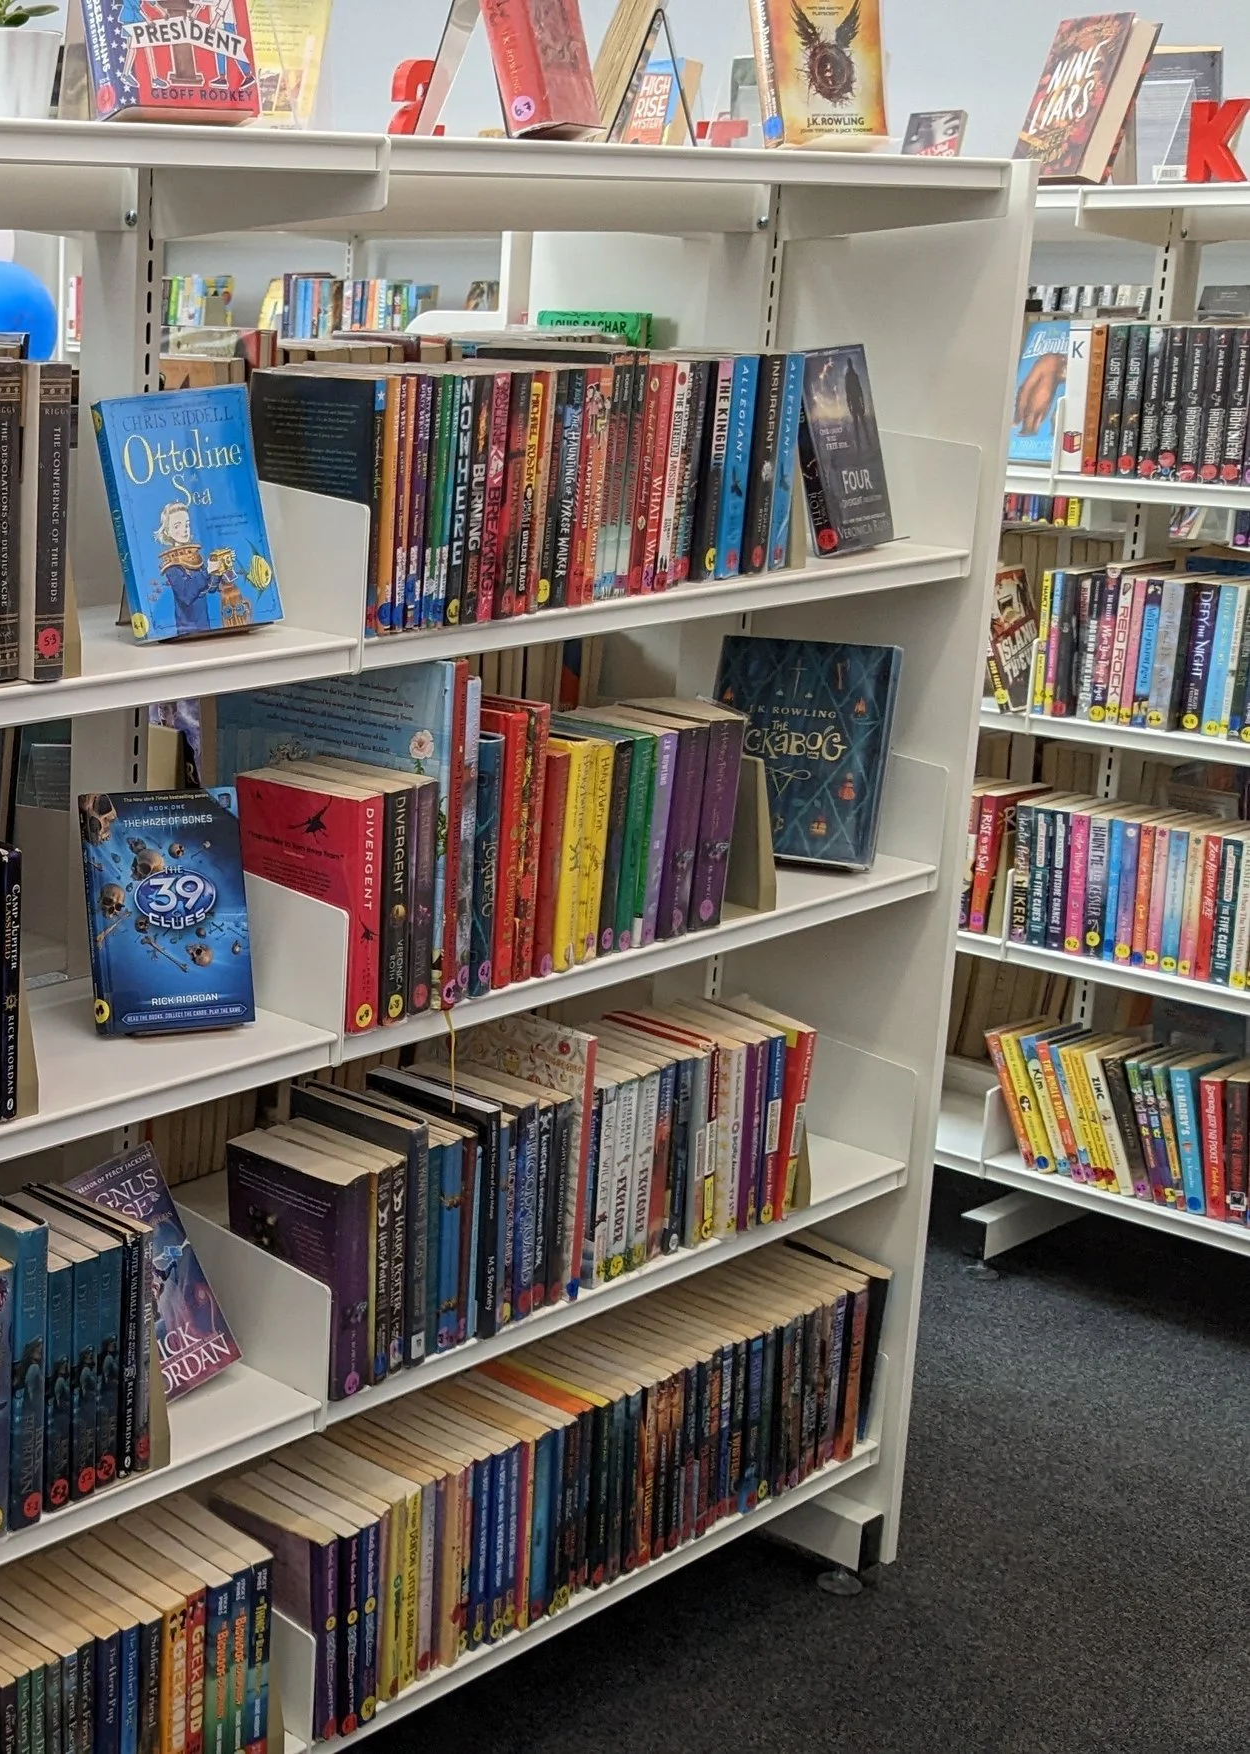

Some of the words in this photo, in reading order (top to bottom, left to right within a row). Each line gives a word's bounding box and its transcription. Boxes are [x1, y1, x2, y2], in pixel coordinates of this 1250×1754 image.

[133, 17, 241, 56] PRESIDENT
[1047, 39, 1111, 94] NINE
[152, 88, 194, 100] GEOFF
[200, 89, 252, 101] RODKEY
[640, 76, 670, 97] HIGH
[635, 96, 668, 118] RISE
[821, 117, 864, 126] ROWLING
[1029, 80, 1096, 134] LIARS
[1185, 97, 1250, 184] K
[1071, 340, 1085, 359] K
[122, 414, 167, 433] CHRIS
[173, 407, 233, 426] RIDDELL
[735, 364, 749, 462] ALLEGIANT
[765, 360, 782, 452] INSURGENT
[123, 429, 243, 485] Ottoline
[52, 451, 61, 526] CONFERENCE
[171, 474, 212, 506] Sea
[841, 469, 873, 494] FOUR
[468, 463, 486, 551] BURNING
[555, 538, 570, 578] WALKER
[50, 569, 58, 603] BIRDS
[1116, 606, 1129, 643] RED
[1198, 591, 1214, 626] DEFY
[1110, 648, 1124, 696] ROCK
[1191, 640, 1210, 680] NIGHT
[772, 707, 836, 718] ROWLING
[772, 720, 789, 731] THE
[142, 818, 166, 826] MAZE
[168, 817, 180, 825] OF
[182, 814, 212, 824] BONES
[364, 807, 375, 911] DIVERGENT
[393, 795, 407, 894] DIVERGENT
[11, 883, 20, 918] CAMP
[149, 875, 205, 913] 39
[149, 908, 206, 930] CLUES
[10, 919, 20, 971] JUPITER
[152, 997, 174, 1006] RICK
[177, 993, 218, 1004] RIORDAN
[7, 1014, 16, 1043] RICK
[6, 1044, 15, 1095] RIORDAN
[124, 1409, 134, 1454] RIORDAN
